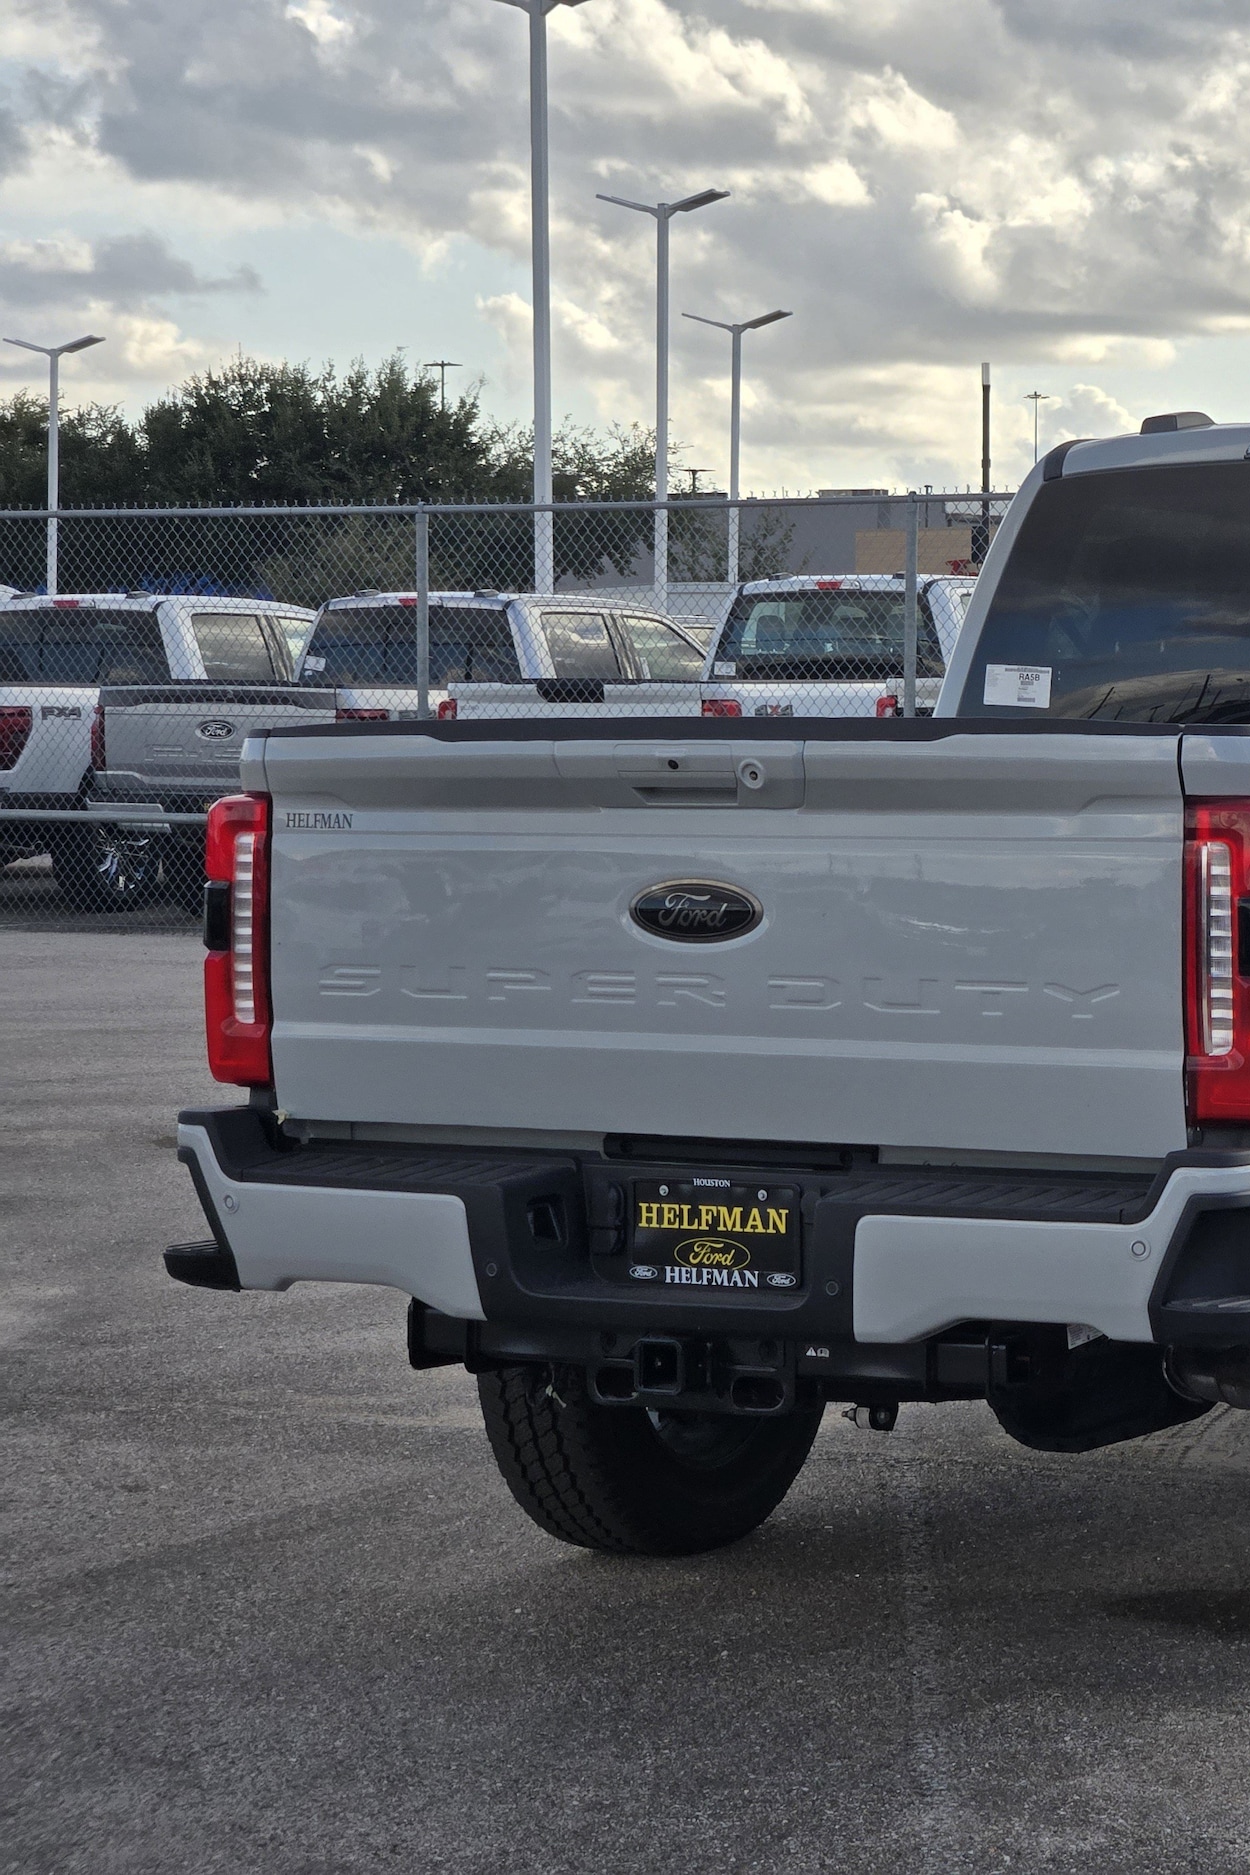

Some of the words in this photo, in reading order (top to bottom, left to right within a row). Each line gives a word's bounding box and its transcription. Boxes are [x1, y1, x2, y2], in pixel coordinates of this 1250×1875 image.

[41, 706, 82, 720] FX4
[205, 724, 227, 736] Ford
[286, 812, 353, 829] HELFMAN
[658, 892, 728, 927] Ford
[318, 963, 727, 1007] SUPER
[767, 974, 1121, 1019] DUTY
[693, 1178, 731, 1188] HOUSTON
[638, 1202, 789, 1234] HELFMAN
[689, 1241, 735, 1266] Ford
[664, 1266, 759, 1288] HELFMAN
